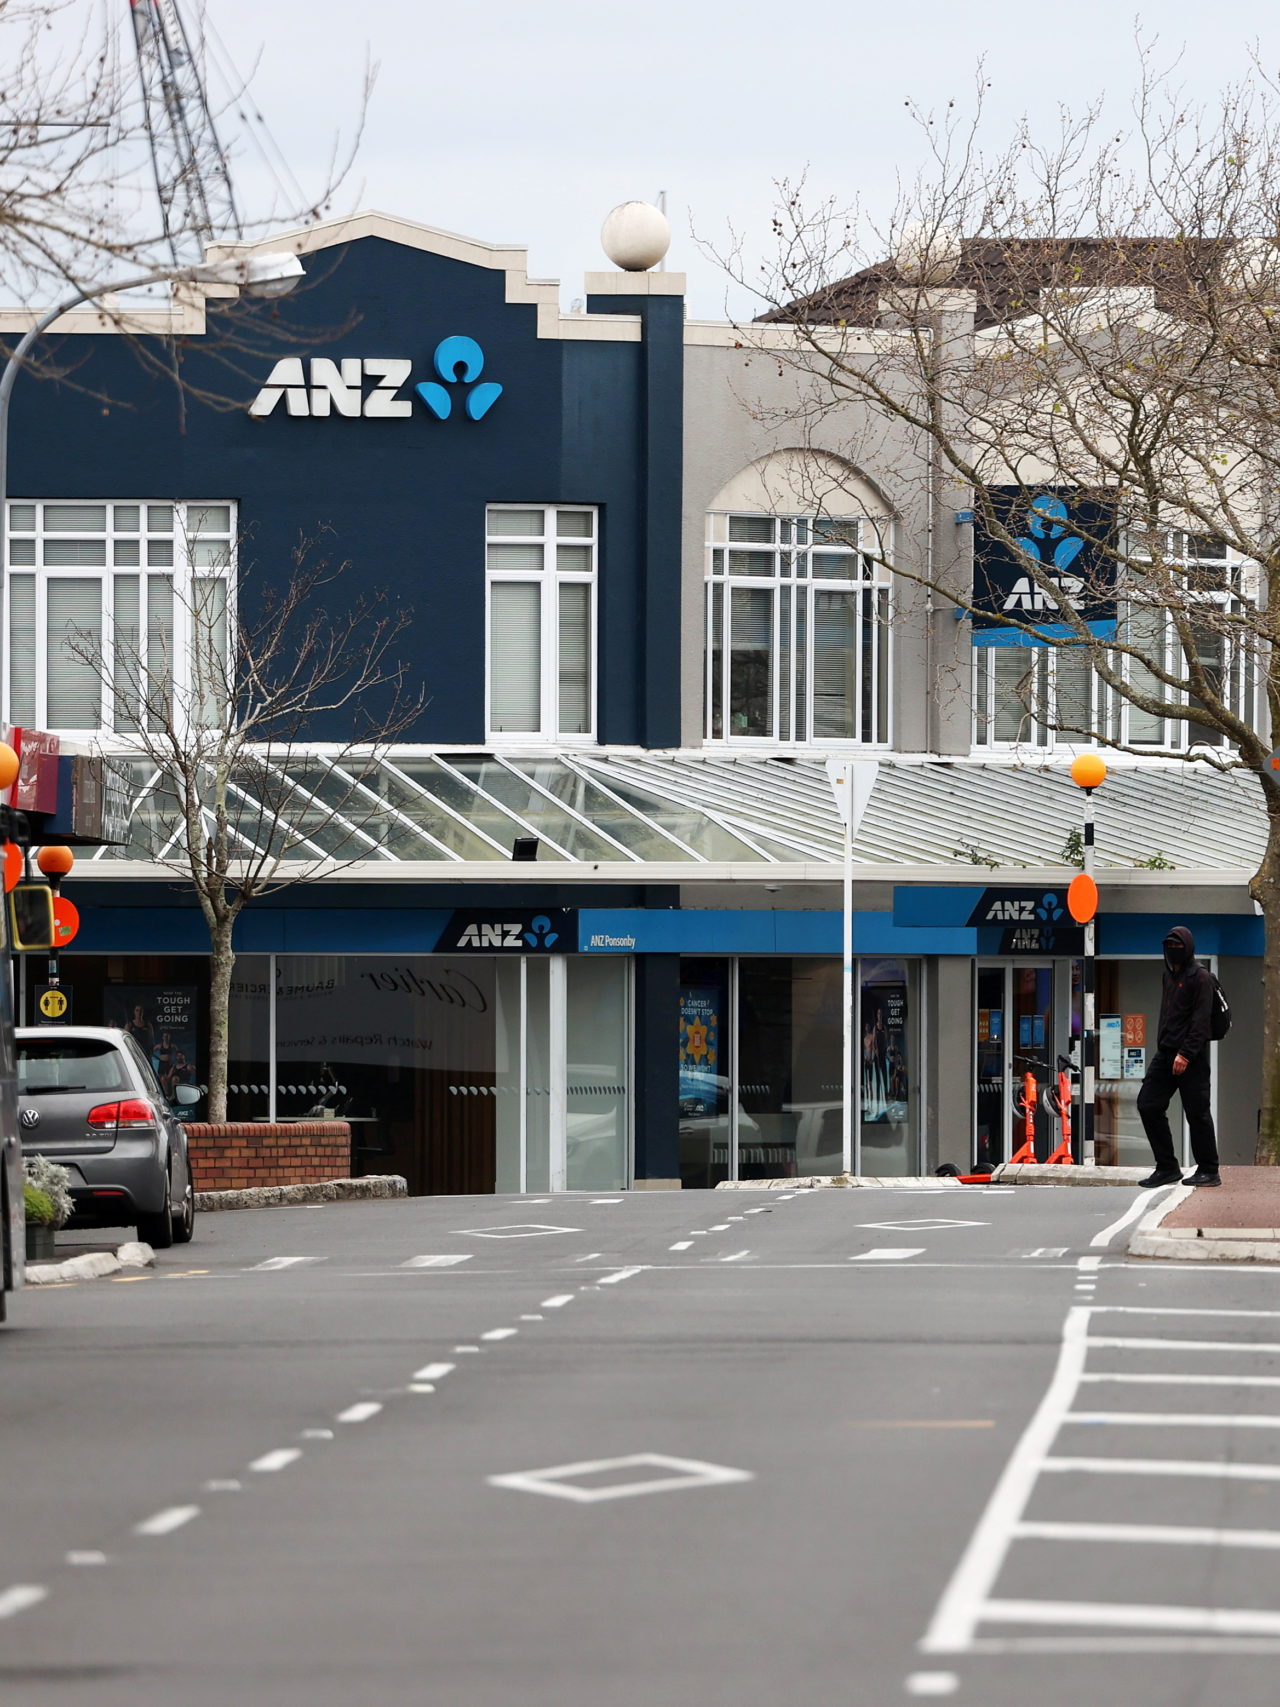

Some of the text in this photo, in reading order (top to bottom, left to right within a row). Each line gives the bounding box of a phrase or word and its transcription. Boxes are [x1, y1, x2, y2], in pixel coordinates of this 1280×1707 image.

[248, 357, 413, 418] ANZ
[1002, 577, 1085, 610] ANZ
[985, 901, 1035, 920] ANZ
[456, 923, 523, 947] ANZ
[1011, 929, 1040, 949] ANZ
[591, 934, 636, 950] ANZ Ponsonby
[156, 997, 191, 1005] TOUGH
[687, 999, 707, 1007] CANCER
[163, 1006, 183, 1014] GET
[890, 1008, 900, 1016] GET
[156, 1015, 189, 1023] GOING
[887, 1017, 903, 1025] GOING
